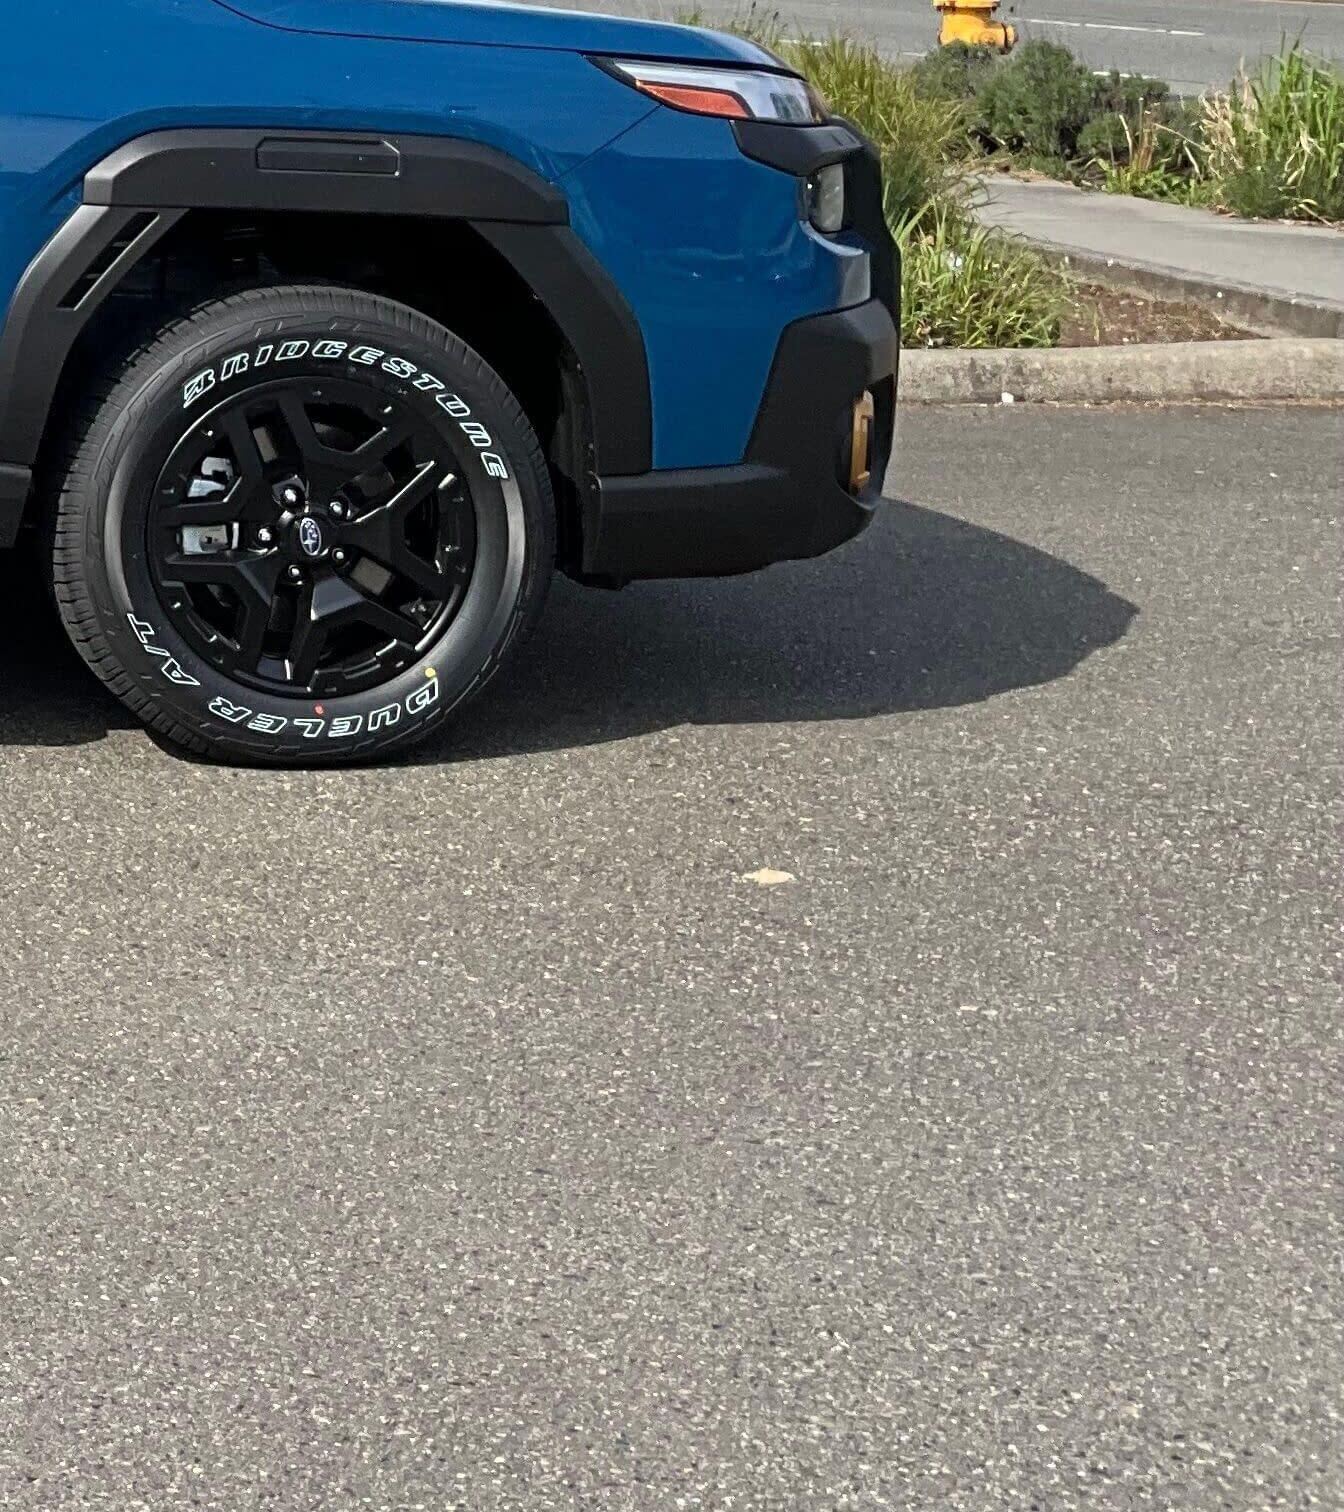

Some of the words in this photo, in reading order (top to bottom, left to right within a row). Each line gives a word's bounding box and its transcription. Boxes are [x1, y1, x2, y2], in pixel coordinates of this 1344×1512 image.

[183, 340, 508, 481] BRIDGESTONE
[127, 613, 201, 686] A/T
[208, 675, 439, 738] DUELER
